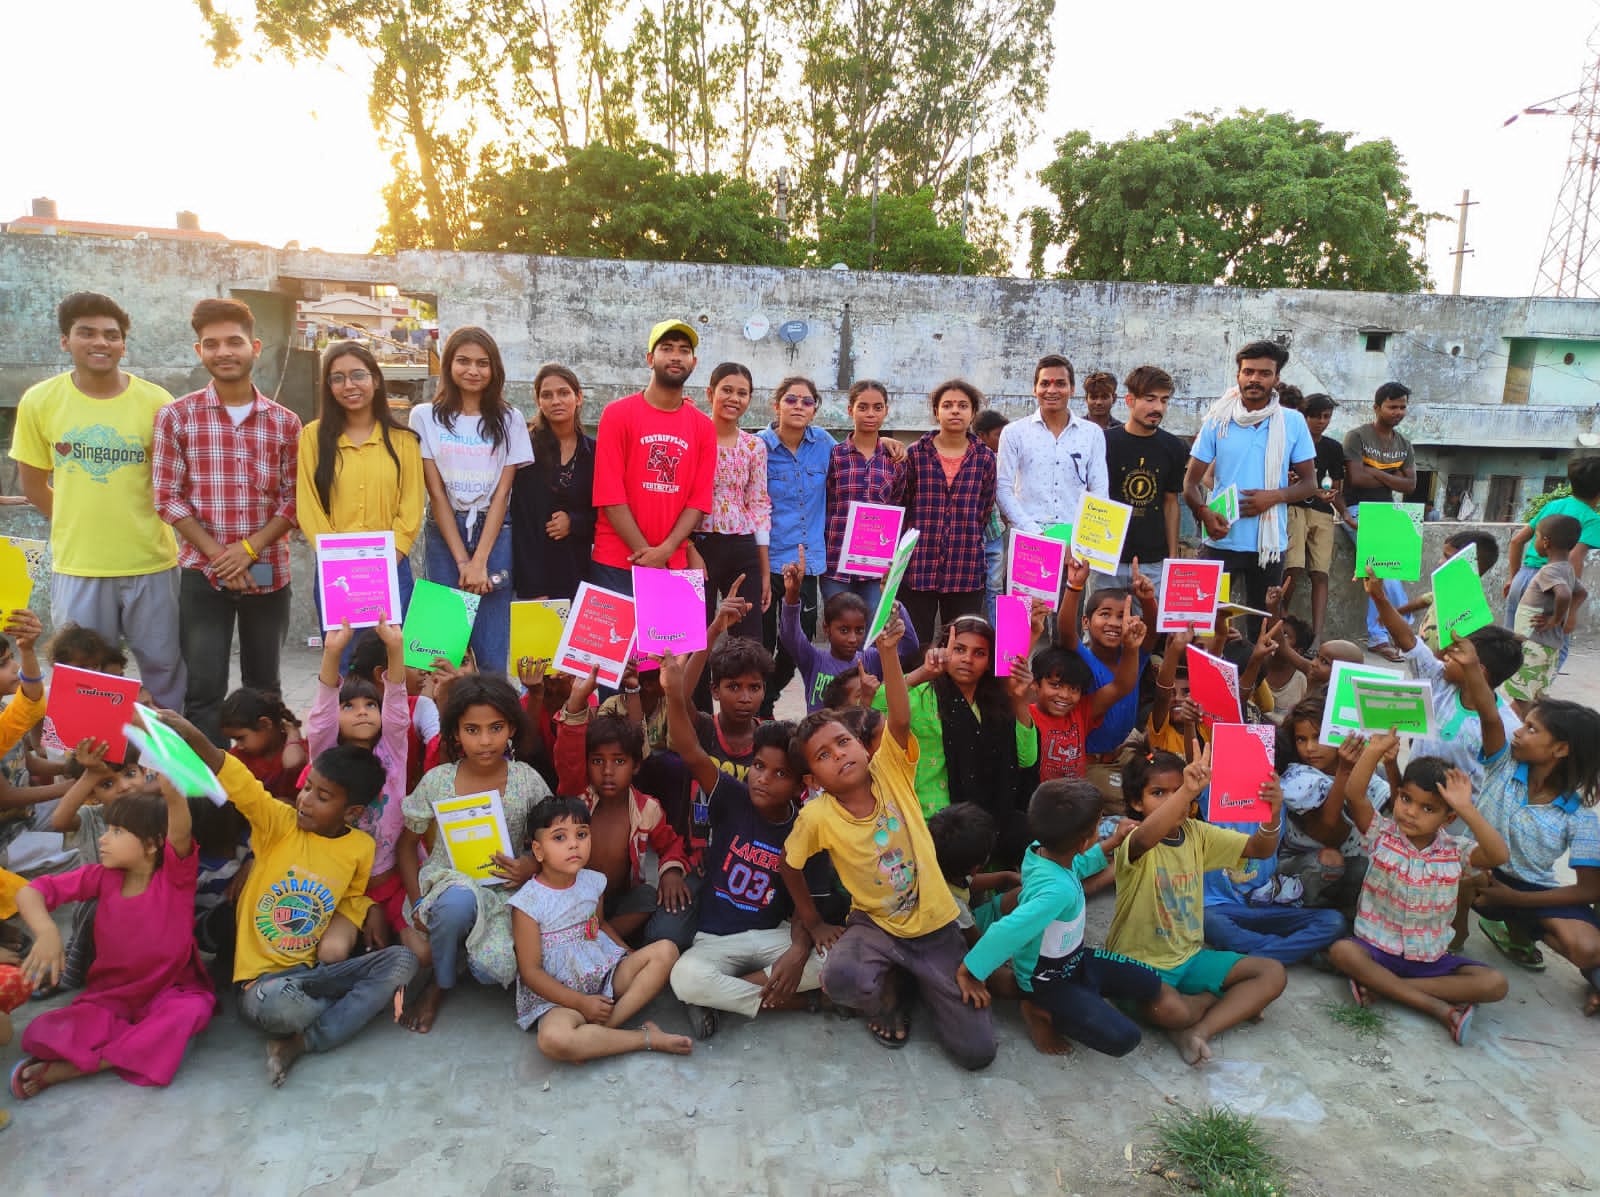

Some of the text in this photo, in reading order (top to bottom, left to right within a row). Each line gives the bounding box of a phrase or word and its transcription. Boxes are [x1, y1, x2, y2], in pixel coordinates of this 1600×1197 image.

[1366, 555, 1401, 568] Campus
[647, 625, 687, 642] Campus
[409, 638, 447, 656] Campus
[76, 687, 124, 705] Campus
[1220, 791, 1256, 809] Campus
[729, 834, 781, 873] LAKER
[727, 862, 770, 901] 03
